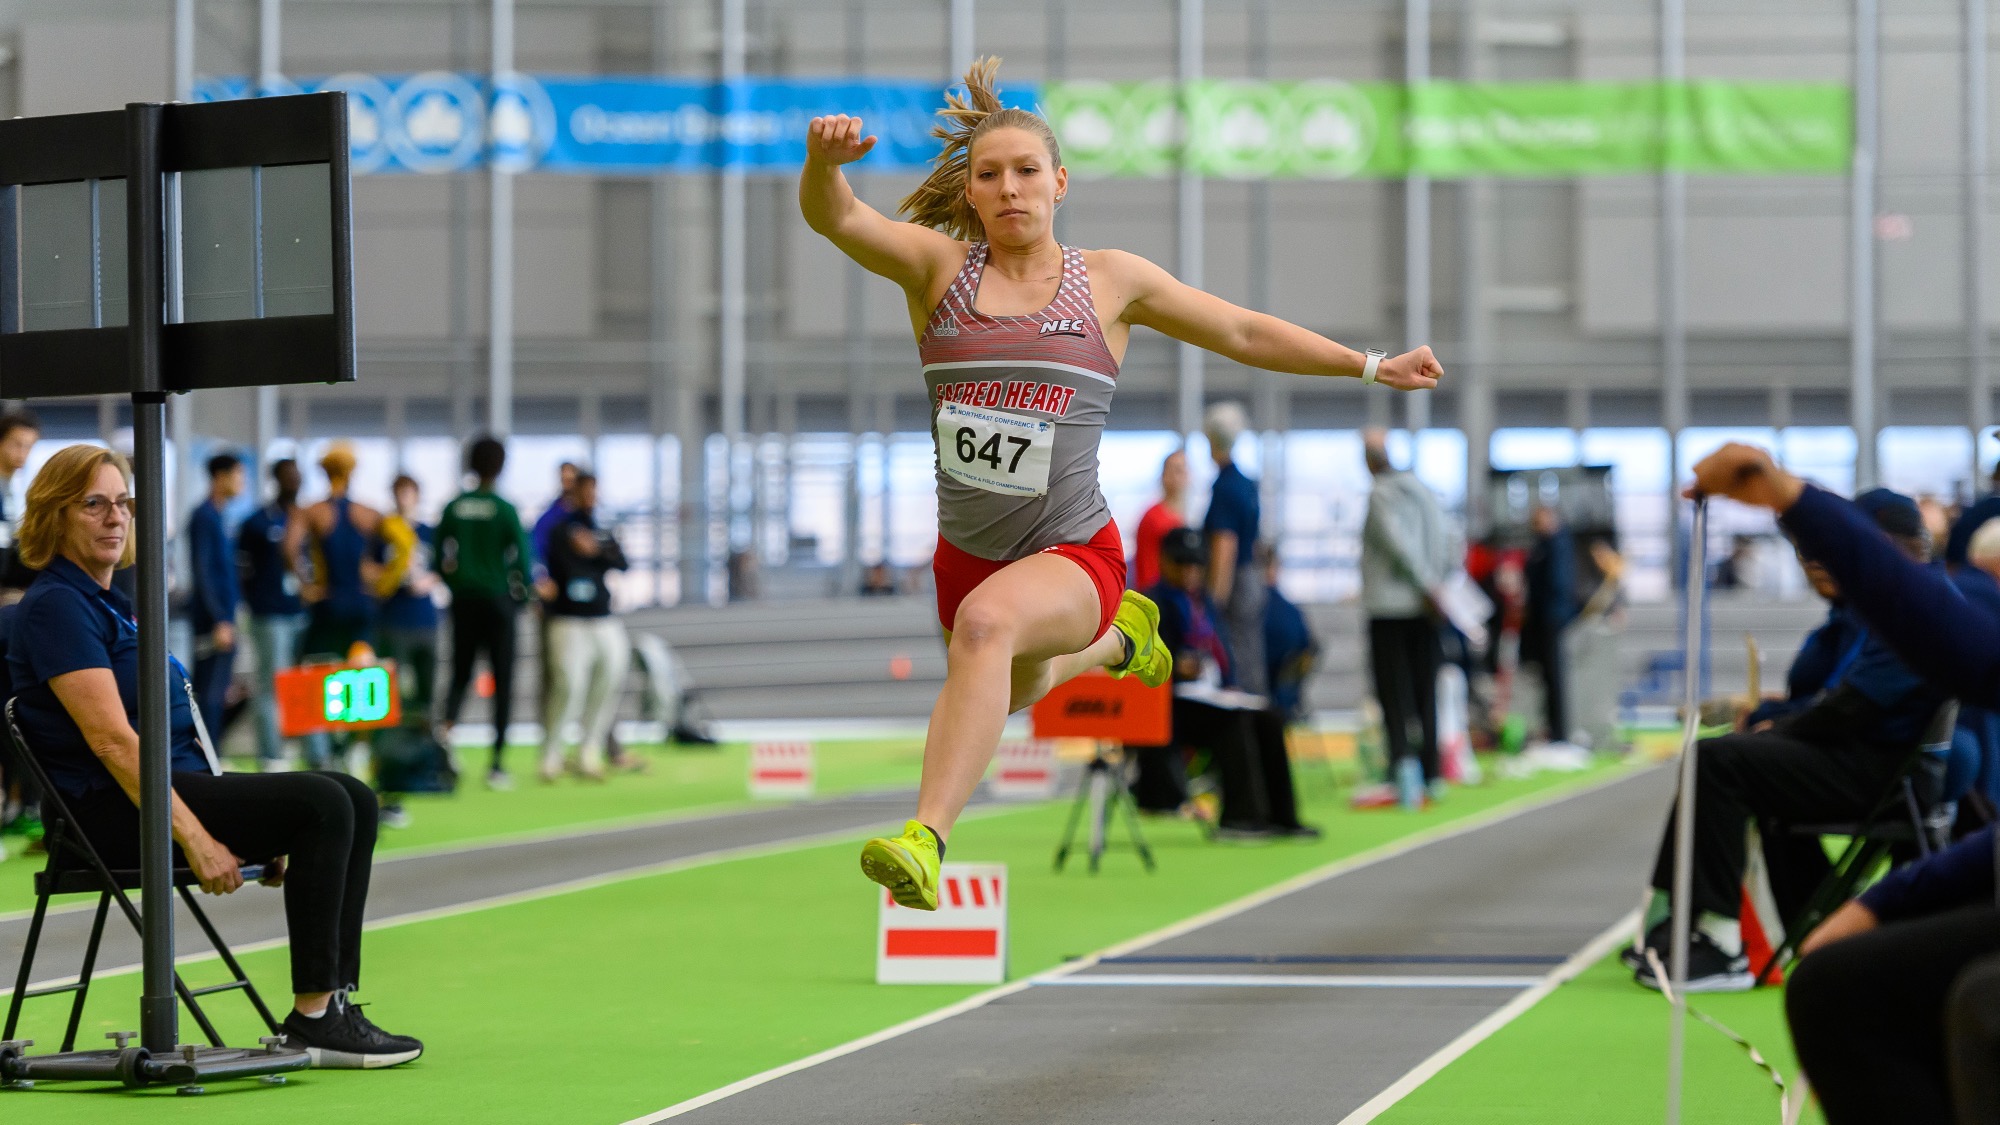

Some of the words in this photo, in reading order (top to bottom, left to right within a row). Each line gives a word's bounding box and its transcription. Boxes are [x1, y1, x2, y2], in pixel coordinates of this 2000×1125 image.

[1039, 319, 1085, 335] NEC
[936, 381, 1002, 411] SACRED
[1002, 381, 1077, 417] HEART
[957, 409, 993, 422] NORTHEAST
[994, 416, 1035, 429] CONFERENCE
[955, 426, 1032, 474] 647
[963, 472, 977, 481] TRACK
[982, 478, 996, 486] FIELD
[995, 481, 1036, 493] CHAMPIONSHIPS
